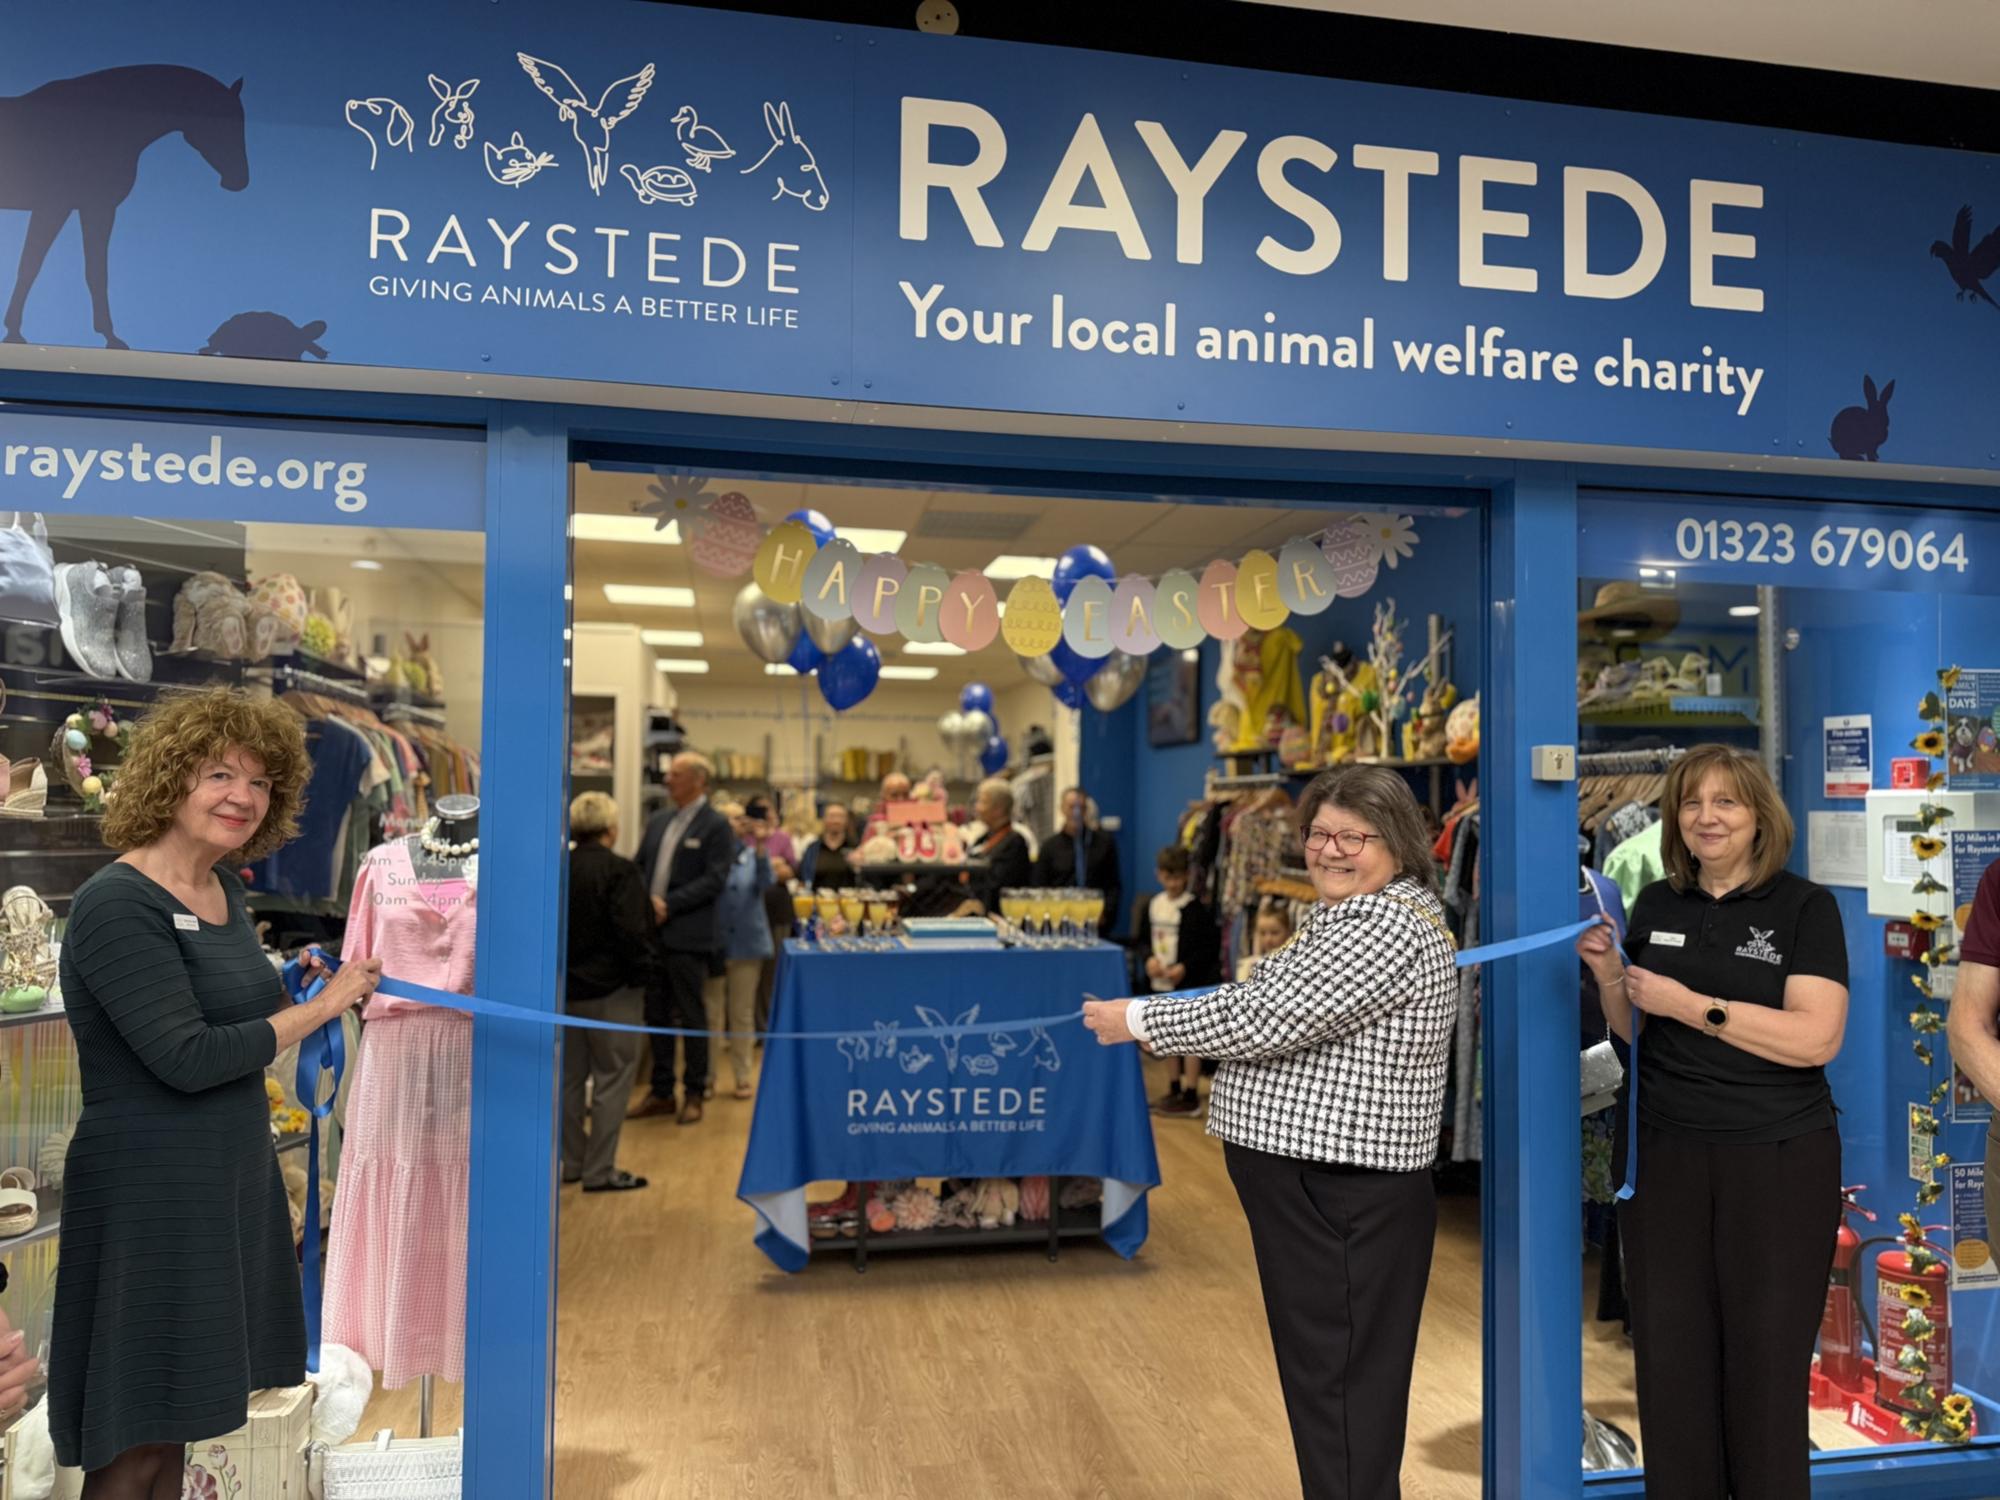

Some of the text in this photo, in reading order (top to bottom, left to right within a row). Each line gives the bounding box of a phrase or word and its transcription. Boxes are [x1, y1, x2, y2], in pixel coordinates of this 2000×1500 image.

[900, 97, 1764, 313] RAYSTEDE
[369, 207, 800, 295] RAYSTEDE
[368, 276, 799, 329] GIVING ANIMALS A BETTER LIFE
[899, 281, 1764, 416] Your local animal welfare charity
[5, 436, 368, 513] raystede.org
[1676, 518, 1970, 573] 01323 679064
[770, 543, 1327, 641] HAPPY EASTER
[1948, 697, 1977, 709] DAYS
[1954, 832, 1966, 843] 50
[1966, 832, 1987, 843] Miles
[387, 871, 443, 891] Sunday
[1735, 945, 1783, 962] RAYSTEDE
[847, 1088, 1047, 1117] RAYSTEDE
[847, 1119, 1046, 1135] GIVING ANIMALS A BETTER LIFE
[1954, 1166, 1984, 1178] 50 Mile
[1880, 1281, 1901, 1298] Foa
